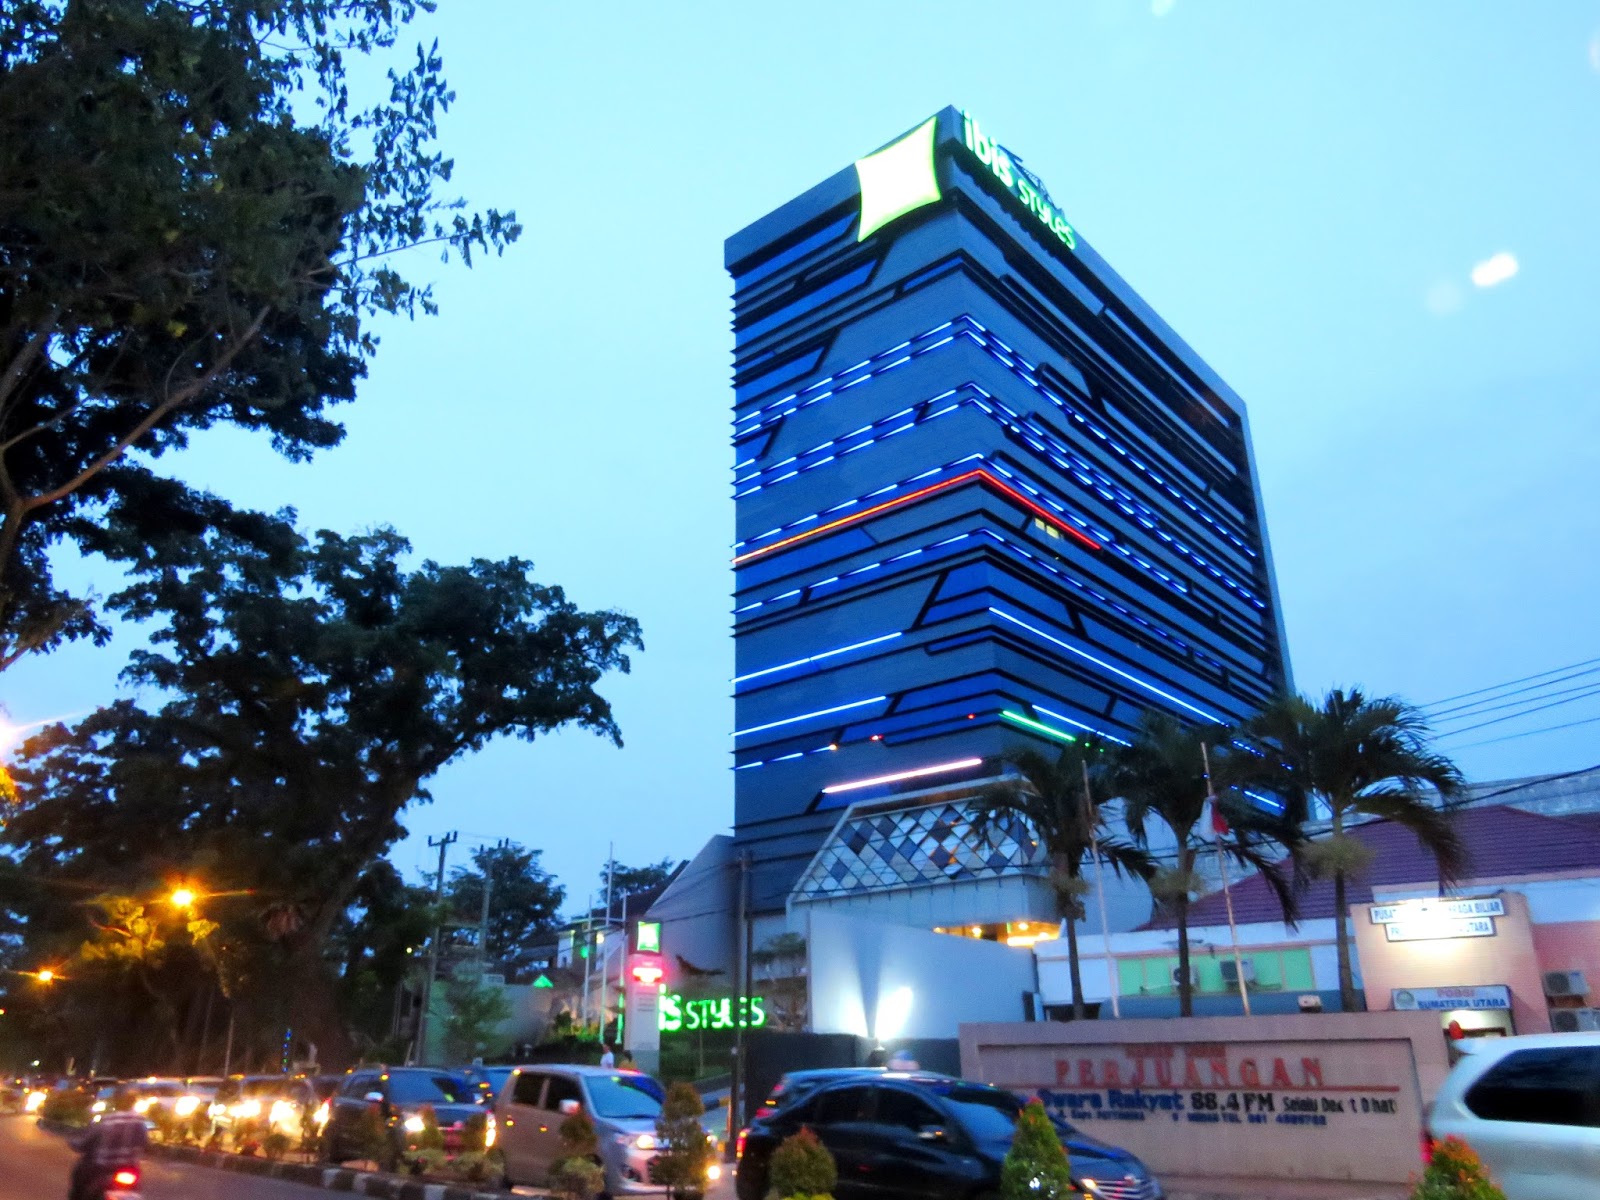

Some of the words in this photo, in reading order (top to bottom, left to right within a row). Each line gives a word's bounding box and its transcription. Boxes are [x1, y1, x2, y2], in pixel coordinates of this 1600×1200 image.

[962, 110, 1013, 187] ibis
[1374, 907, 1397, 920] PUSA
[1473, 999, 1506, 1008] UTARA
[1055, 1057, 1323, 1088] PERJUANGAN
[1191, 1092, 1240, 1111] 88.4
[1243, 1092, 1275, 1113] FM
